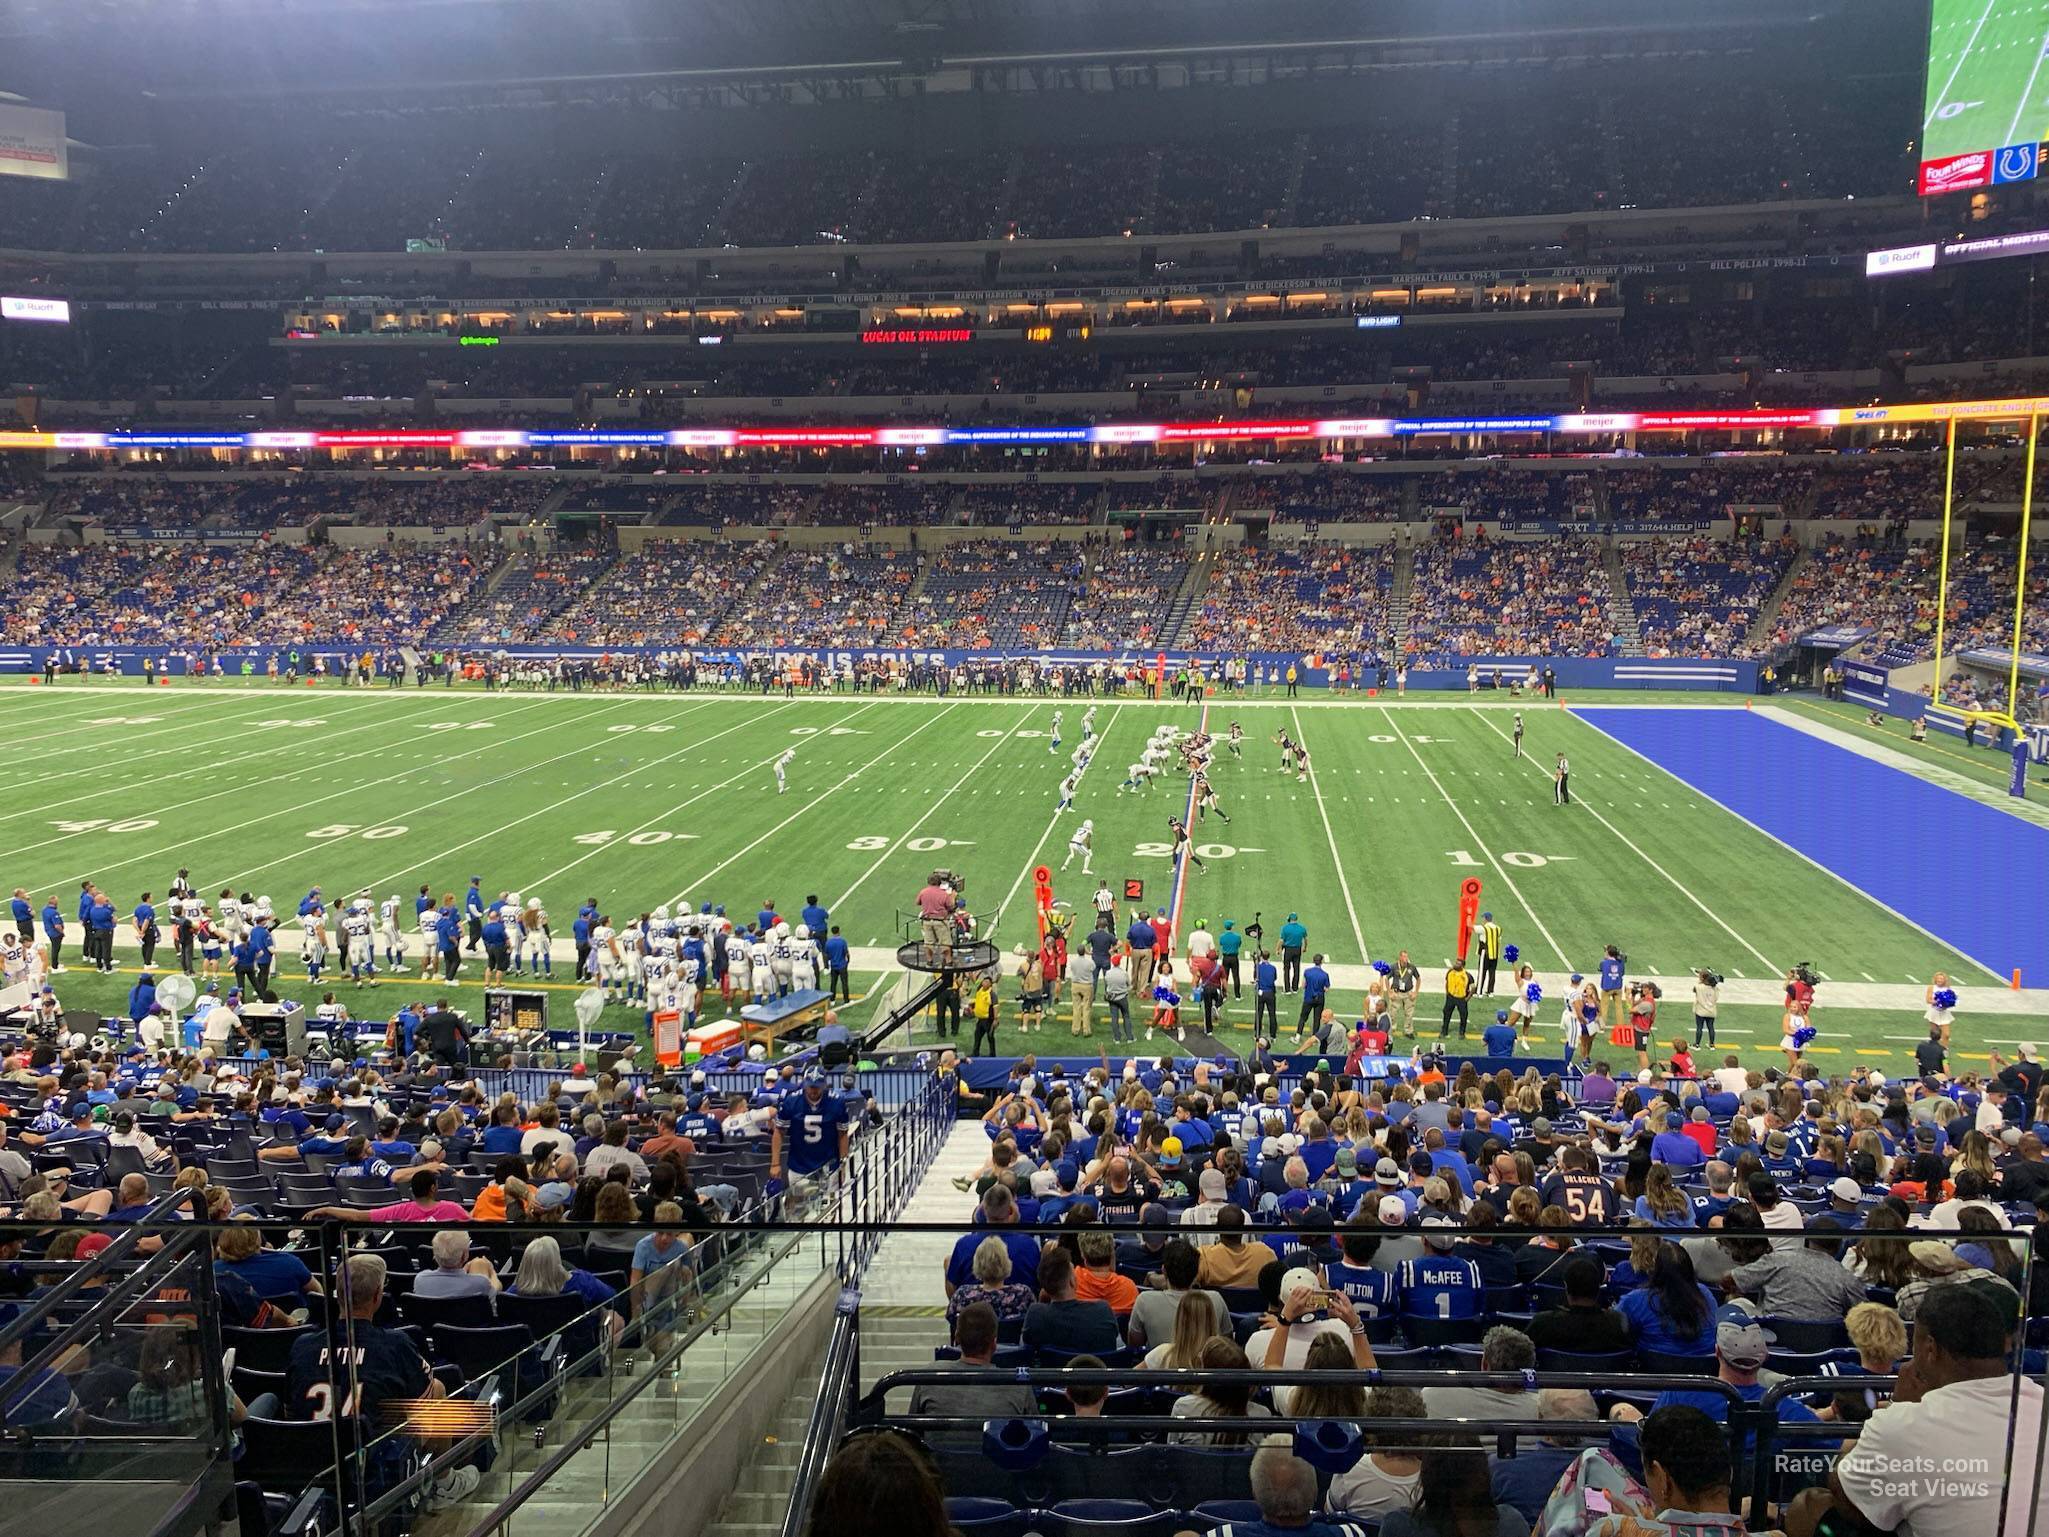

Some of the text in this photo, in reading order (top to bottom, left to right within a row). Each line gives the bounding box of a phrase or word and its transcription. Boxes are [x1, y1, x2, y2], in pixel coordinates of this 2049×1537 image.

[1892, 251, 1921, 262] Ruoff
[1552, 269, 1573, 277] JEFF
[1574, 266, 1619, 276] SATURDAY
[1710, 262, 1732, 270] BILL
[1734, 260, 1769, 269] POLIAN
[1392, 275, 1437, 285] MARSHALL
[1438, 273, 1465, 282] FAULK
[862, 329, 971, 343] LUCAS OIL STADIUM
[1583, 417, 1614, 427] meijer
[152, 529, 179, 538] TEXT
[305, 824, 410, 840] 50
[572, 829, 675, 846] 40
[846, 836, 953, 851] 30
[1445, 850, 1549, 868] 10
[1126, 882, 1141, 897] 2
[1617, 1028, 1631, 1044] 10
[803, 1115, 823, 1144] 5
[1563, 1174, 1602, 1185] URLACHER
[1565, 1187, 1606, 1223] 54
[1423, 1269, 1464, 1286] McAFEE
[1344, 1281, 1374, 1299] HILTON
[1435, 1292, 1450, 1319] 1
